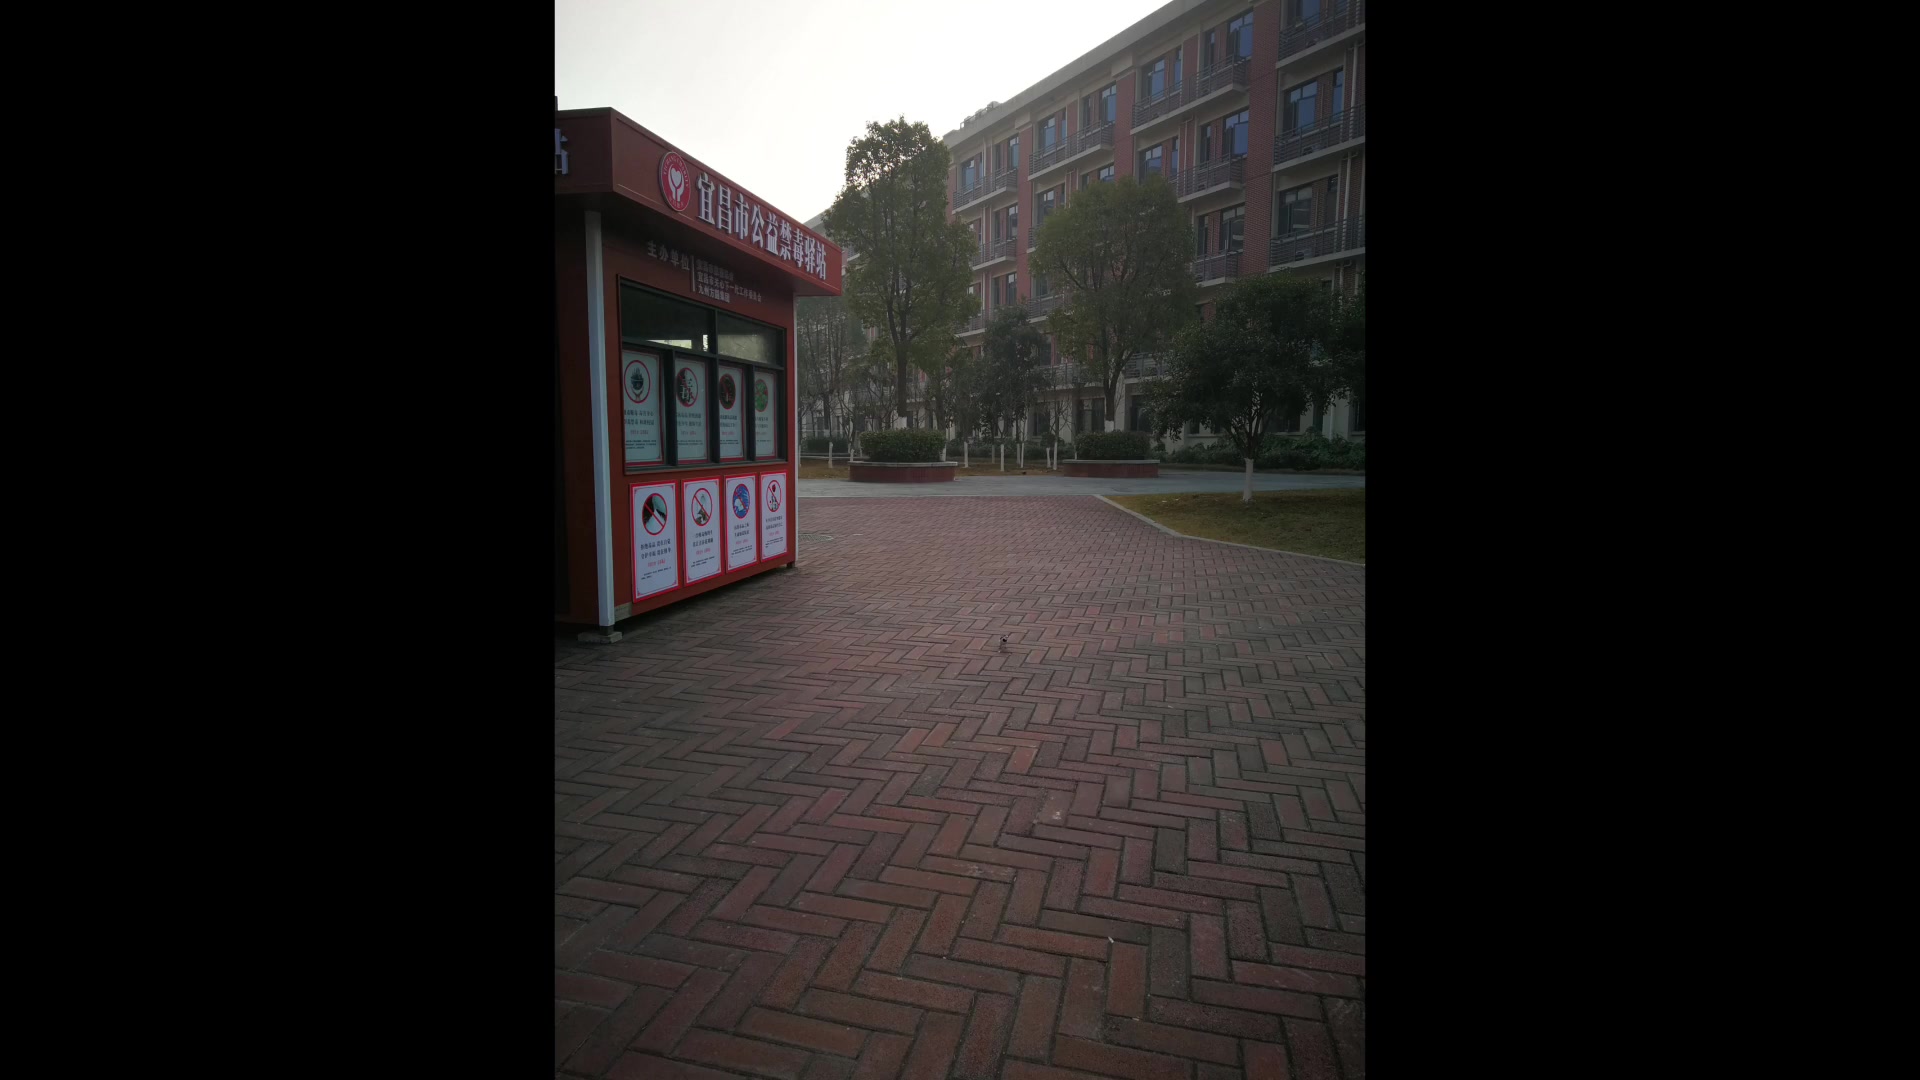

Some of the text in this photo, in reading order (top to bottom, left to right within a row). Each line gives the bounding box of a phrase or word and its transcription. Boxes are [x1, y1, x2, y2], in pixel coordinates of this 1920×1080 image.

[647, 240, 690, 271] 主办单位
[697, 172, 827, 280] 宜昌市公益禁毒驿站
